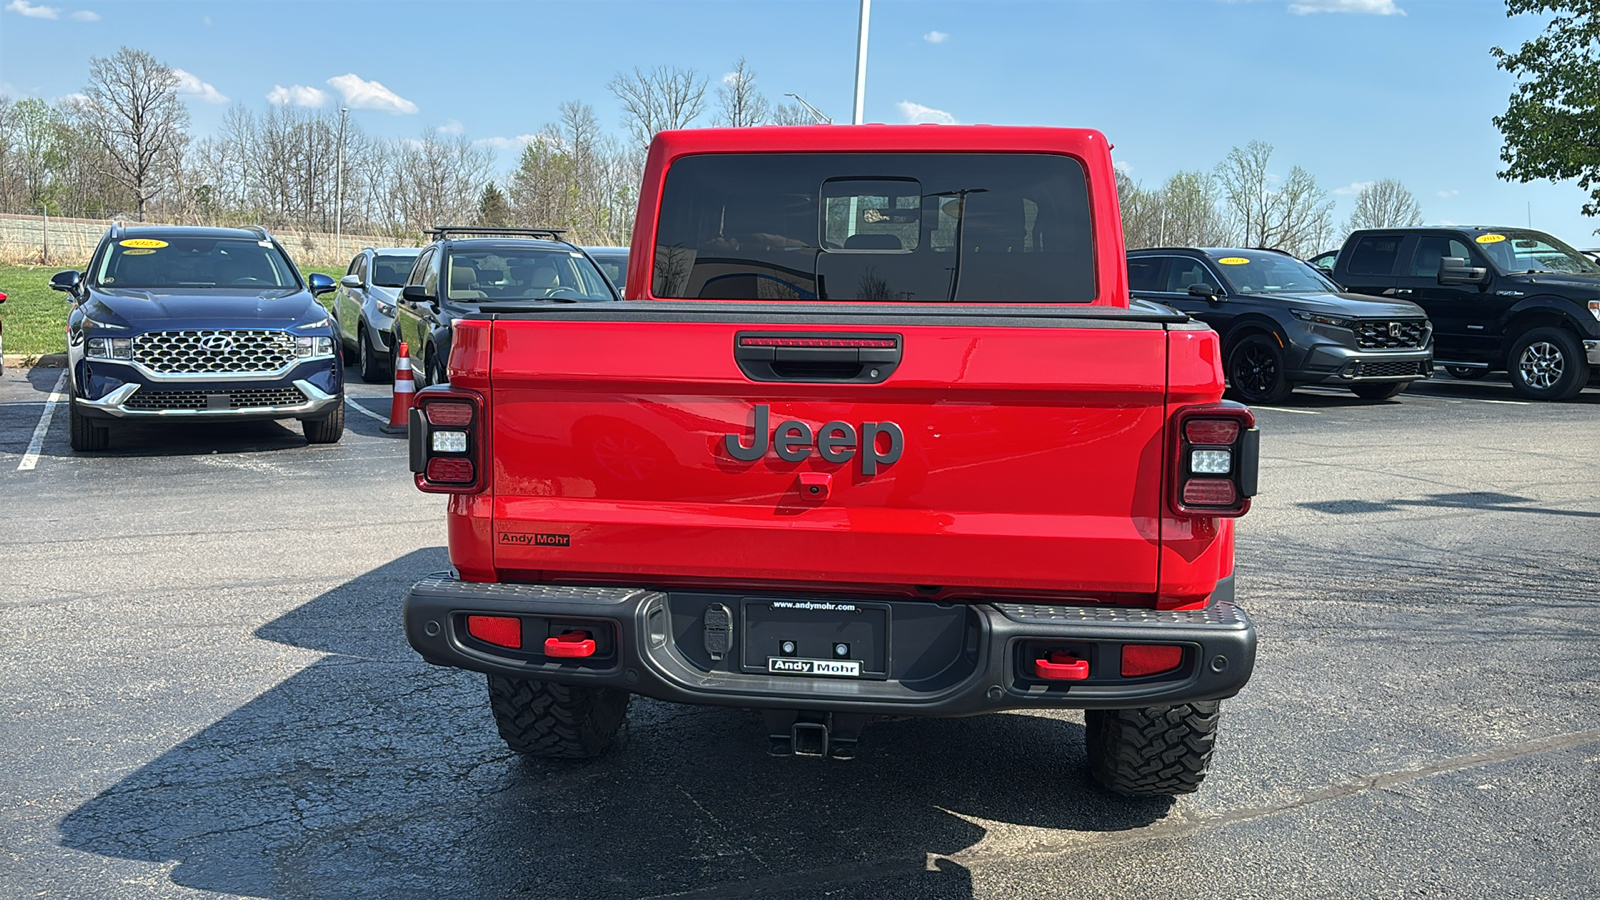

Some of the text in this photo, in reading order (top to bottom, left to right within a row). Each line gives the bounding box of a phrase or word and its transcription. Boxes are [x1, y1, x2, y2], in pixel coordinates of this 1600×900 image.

[725, 404, 904, 475] Jeep
[502, 533, 568, 544] Andy Mohr
[773, 601, 855, 611] www.andymohr.com
[774, 660, 857, 674] Andy Mohr
